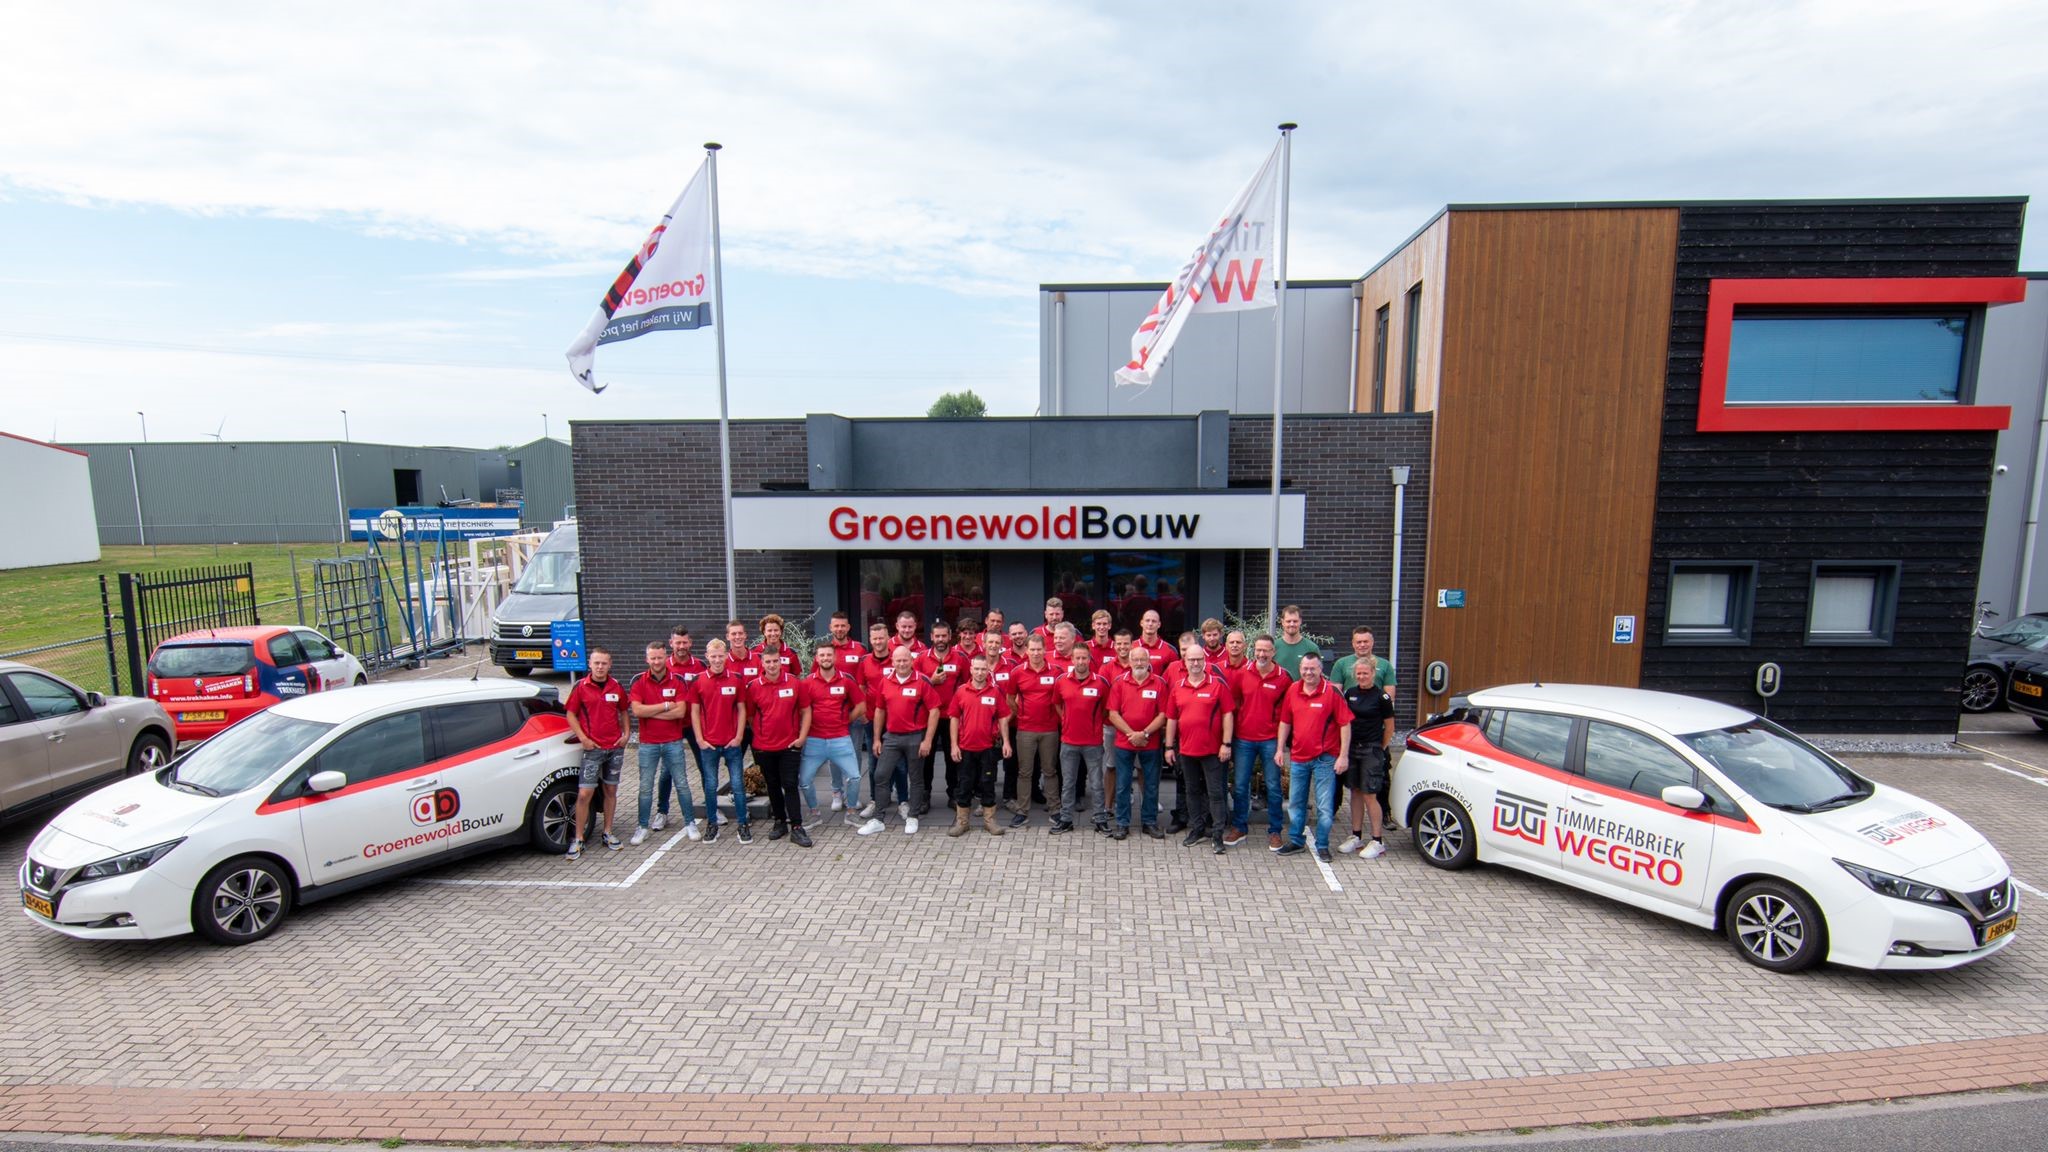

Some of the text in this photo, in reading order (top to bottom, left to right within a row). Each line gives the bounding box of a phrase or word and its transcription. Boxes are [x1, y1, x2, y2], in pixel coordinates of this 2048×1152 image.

[829, 506, 1200, 541] GroenewoldBouw
[532, 767, 580, 800] 100% elekt
[1408, 779, 1473, 812] 100% elektrisch
[363, 812, 504, 859] GroenewoldBouw
[1554, 825, 1684, 887] WEGRO
